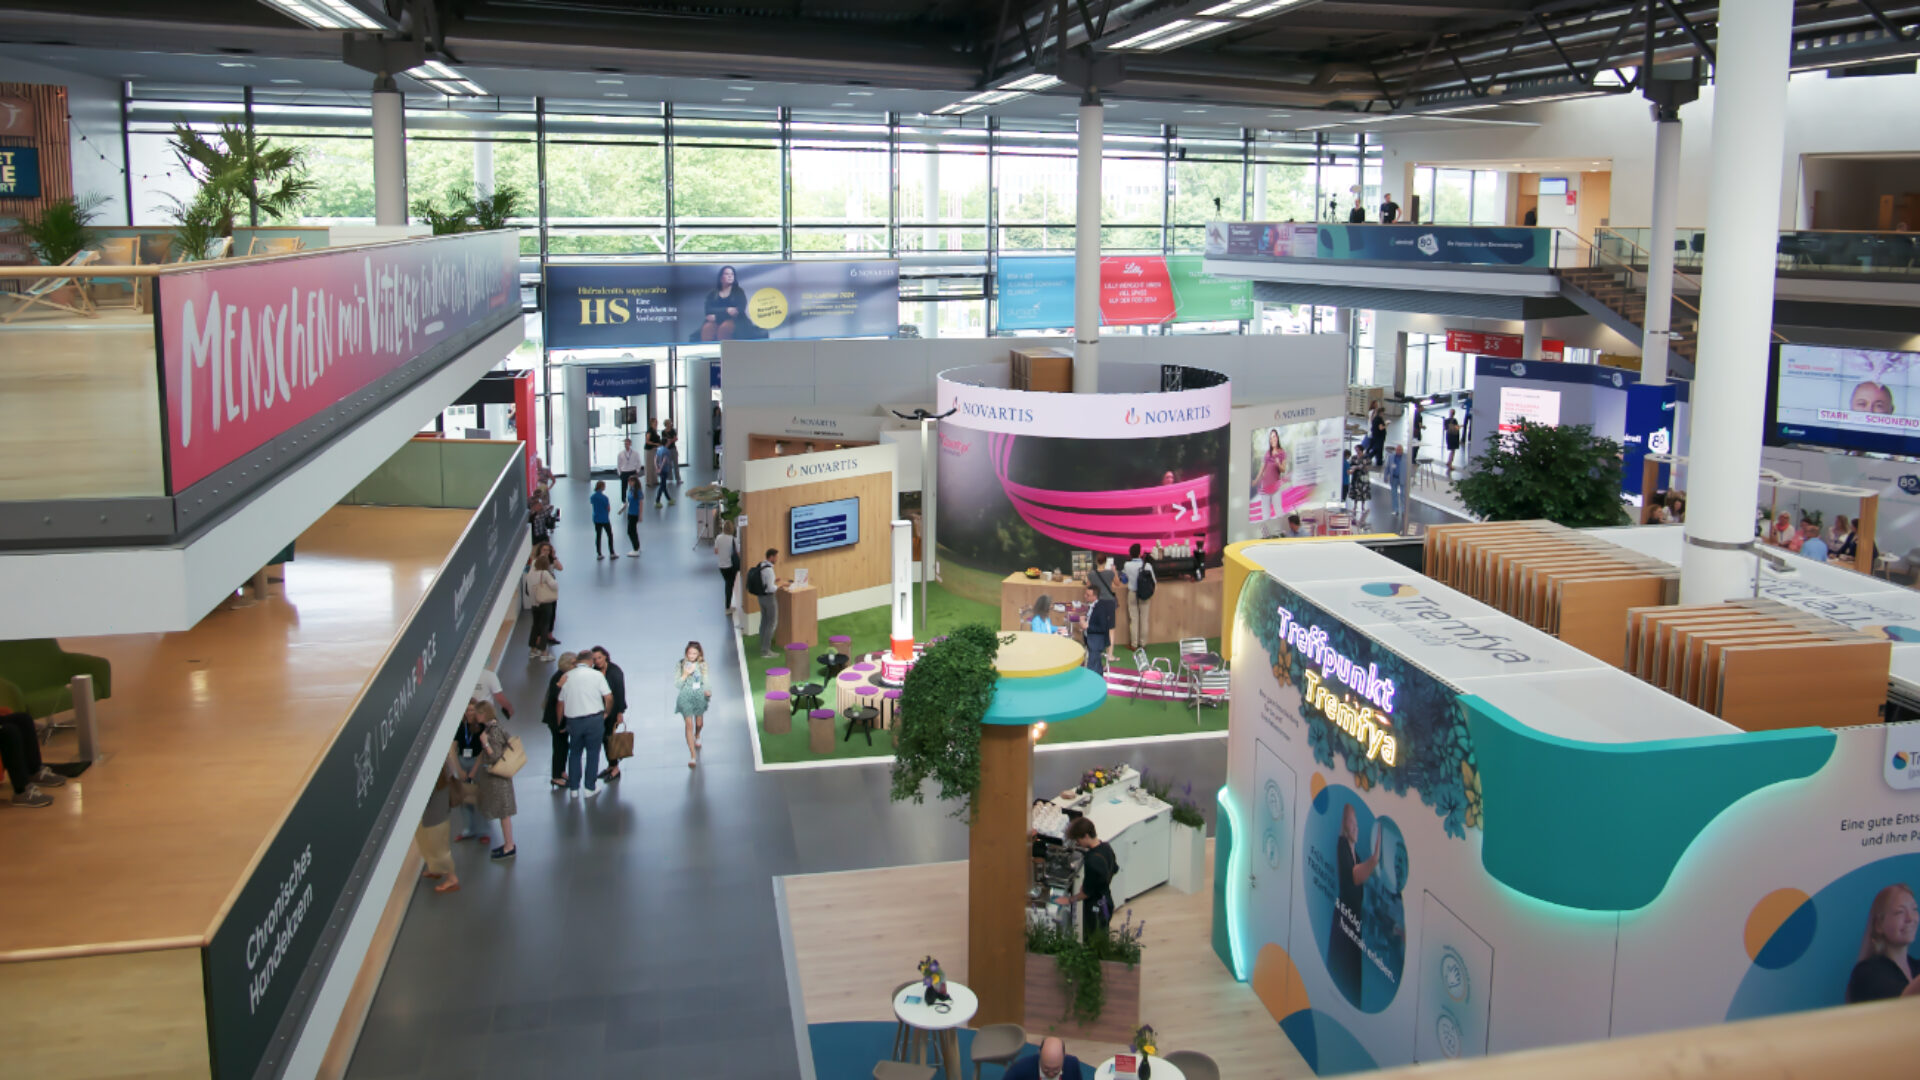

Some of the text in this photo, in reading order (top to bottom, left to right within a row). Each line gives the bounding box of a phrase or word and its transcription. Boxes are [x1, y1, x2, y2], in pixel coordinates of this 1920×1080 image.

[858, 269, 894, 277] NOVARTIS
[1123, 262, 1144, 277] Lilly
[579, 298, 630, 325] HS
[1484, 340, 1500, 351] 2-5
[962, 401, 1035, 423] NOVARTIS
[1145, 405, 1212, 425] NOVARTIS
[1282, 408, 1316, 420] NOVARTIS
[1820, 410, 1849, 421] STARK
[1865, 415, 1919, 428] SCHONEND
[800, 418, 837, 428] NOVARTIS
[800, 459, 858, 476] NOVARTIS
[1396, 596, 1531, 663] Tremfya
[1277, 605, 1395, 714] Treffpunkt
[380, 632, 437, 752] DERMAFORCE
[1304, 668, 1397, 768] Tremfya
[1841, 819, 1865, 831] Eine
[1867, 817, 1893, 831] gute
[1861, 833, 1883, 847] und
[1885, 832, 1908, 844] Ihre
[246, 843, 312, 970] Chronisches
[250, 883, 313, 1015] Handekzem
